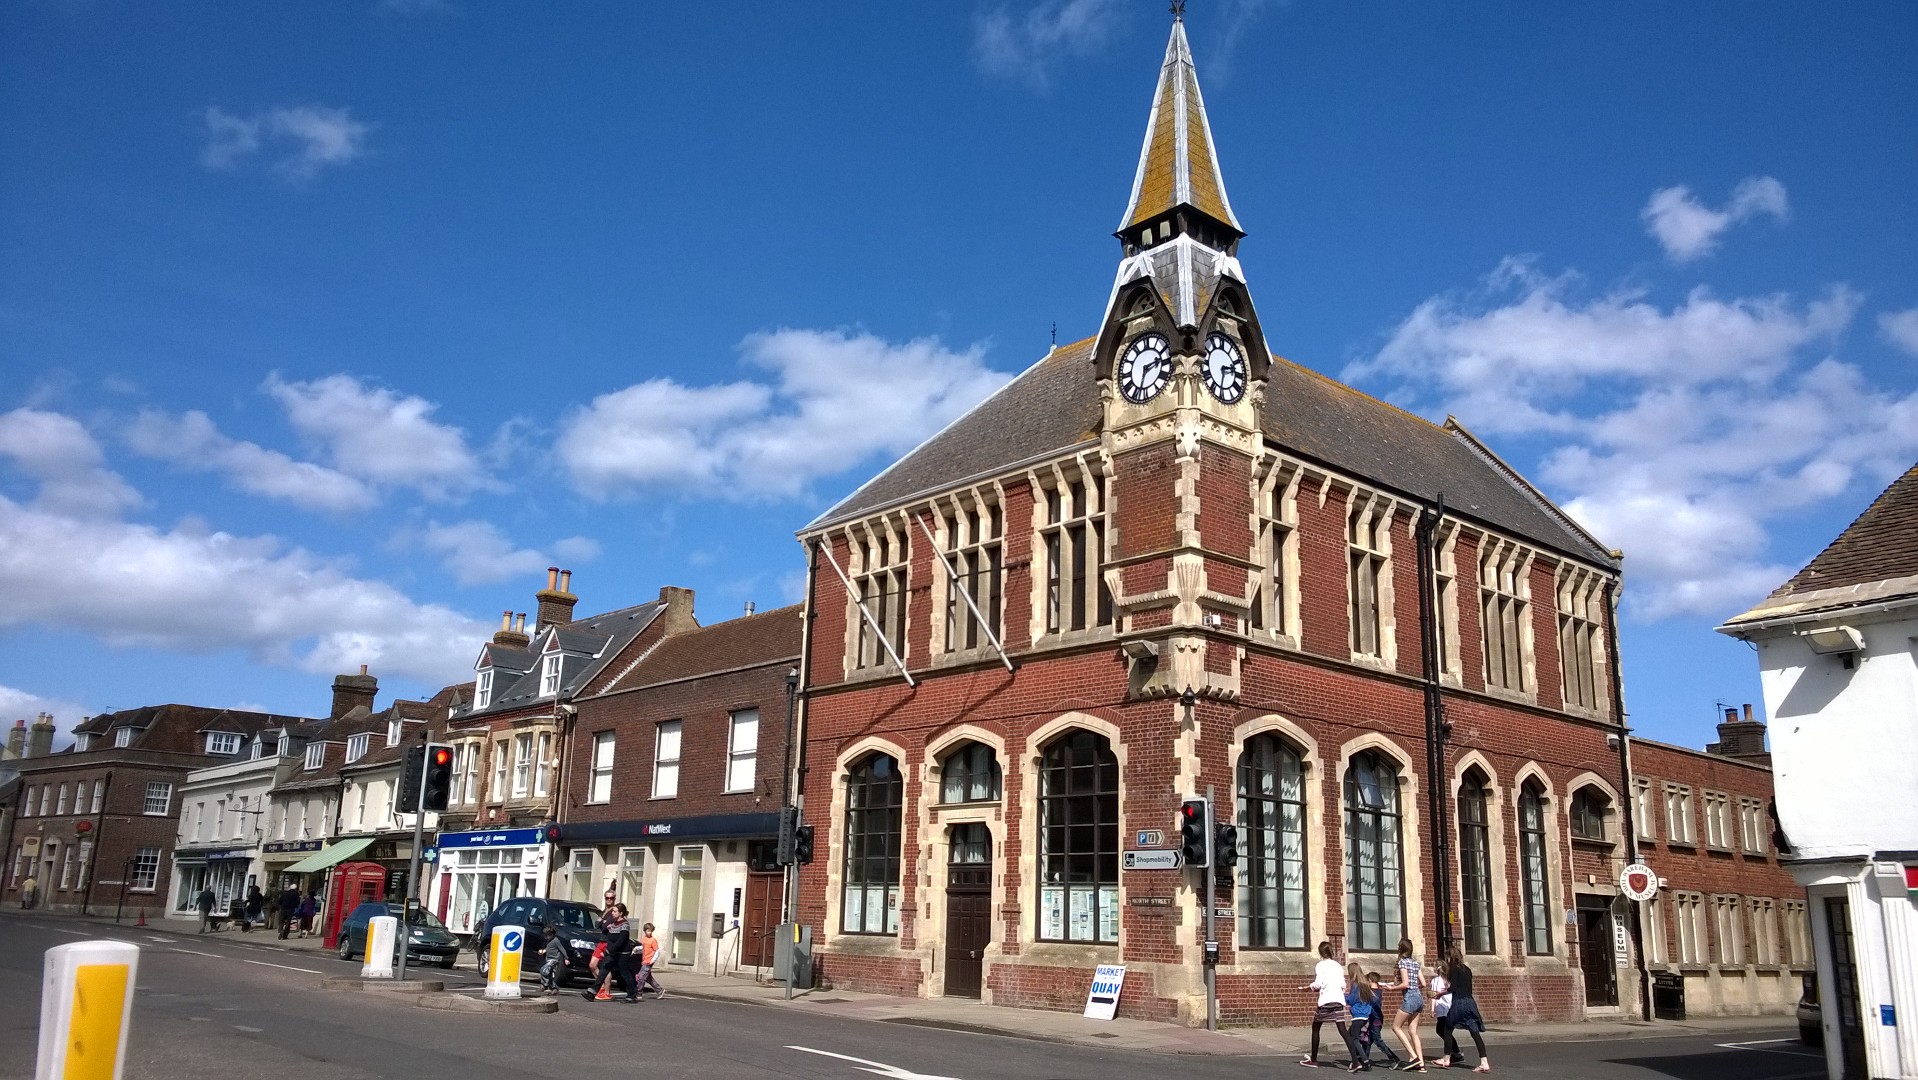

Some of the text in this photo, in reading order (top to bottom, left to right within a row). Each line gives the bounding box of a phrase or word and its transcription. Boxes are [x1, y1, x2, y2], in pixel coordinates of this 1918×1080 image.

[648, 823, 671, 834] NatWest
[1140, 834, 1146, 843] P
[1136, 856, 1172, 864] Shopmobility
[1622, 865, 1654, 879] WAREHAM
[1621, 879, 1656, 899] TOWN MUSEUM
[1614, 915, 1625, 951] MUSEUM
[1097, 967, 1124, 976] MARKET
[1091, 981, 1121, 994] QUAY
